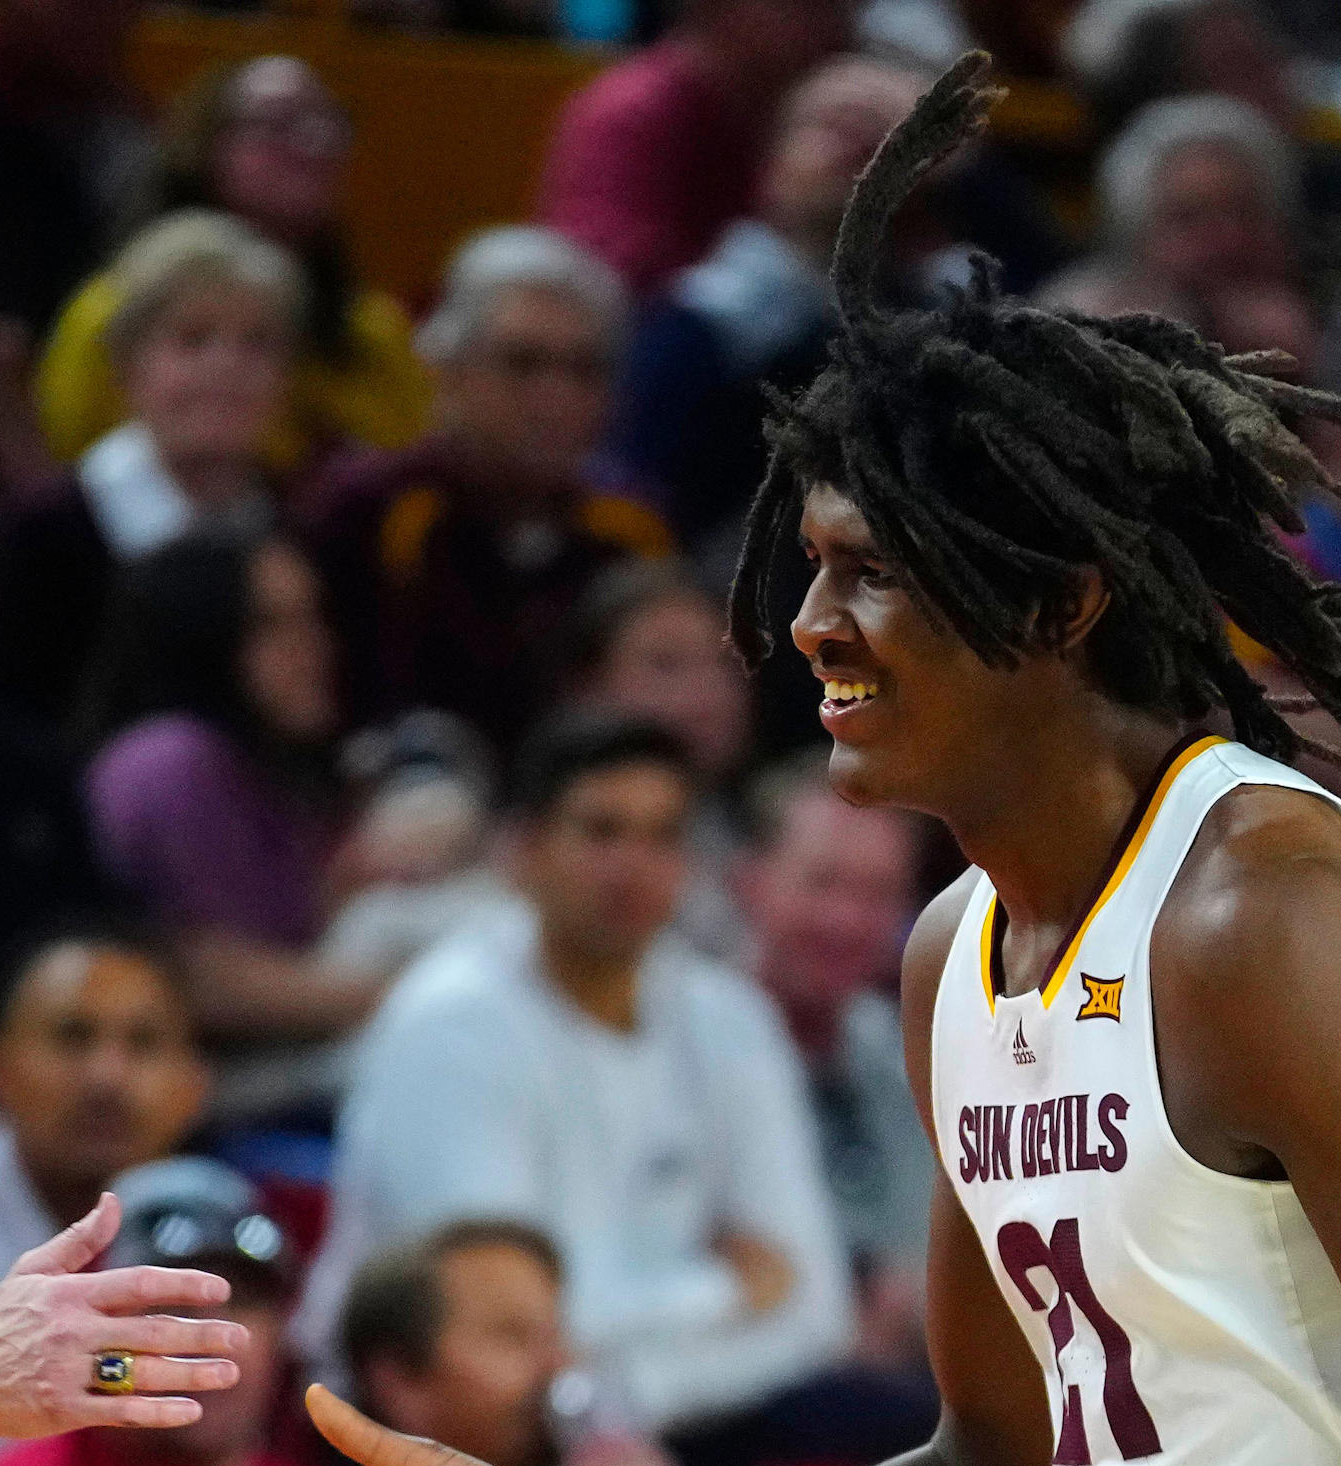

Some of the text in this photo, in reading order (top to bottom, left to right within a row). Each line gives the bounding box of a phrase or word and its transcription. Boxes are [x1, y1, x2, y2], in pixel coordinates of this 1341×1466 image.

[959, 1093, 1130, 1184] SUN DEVILS
[997, 1217, 1163, 1466] 21
